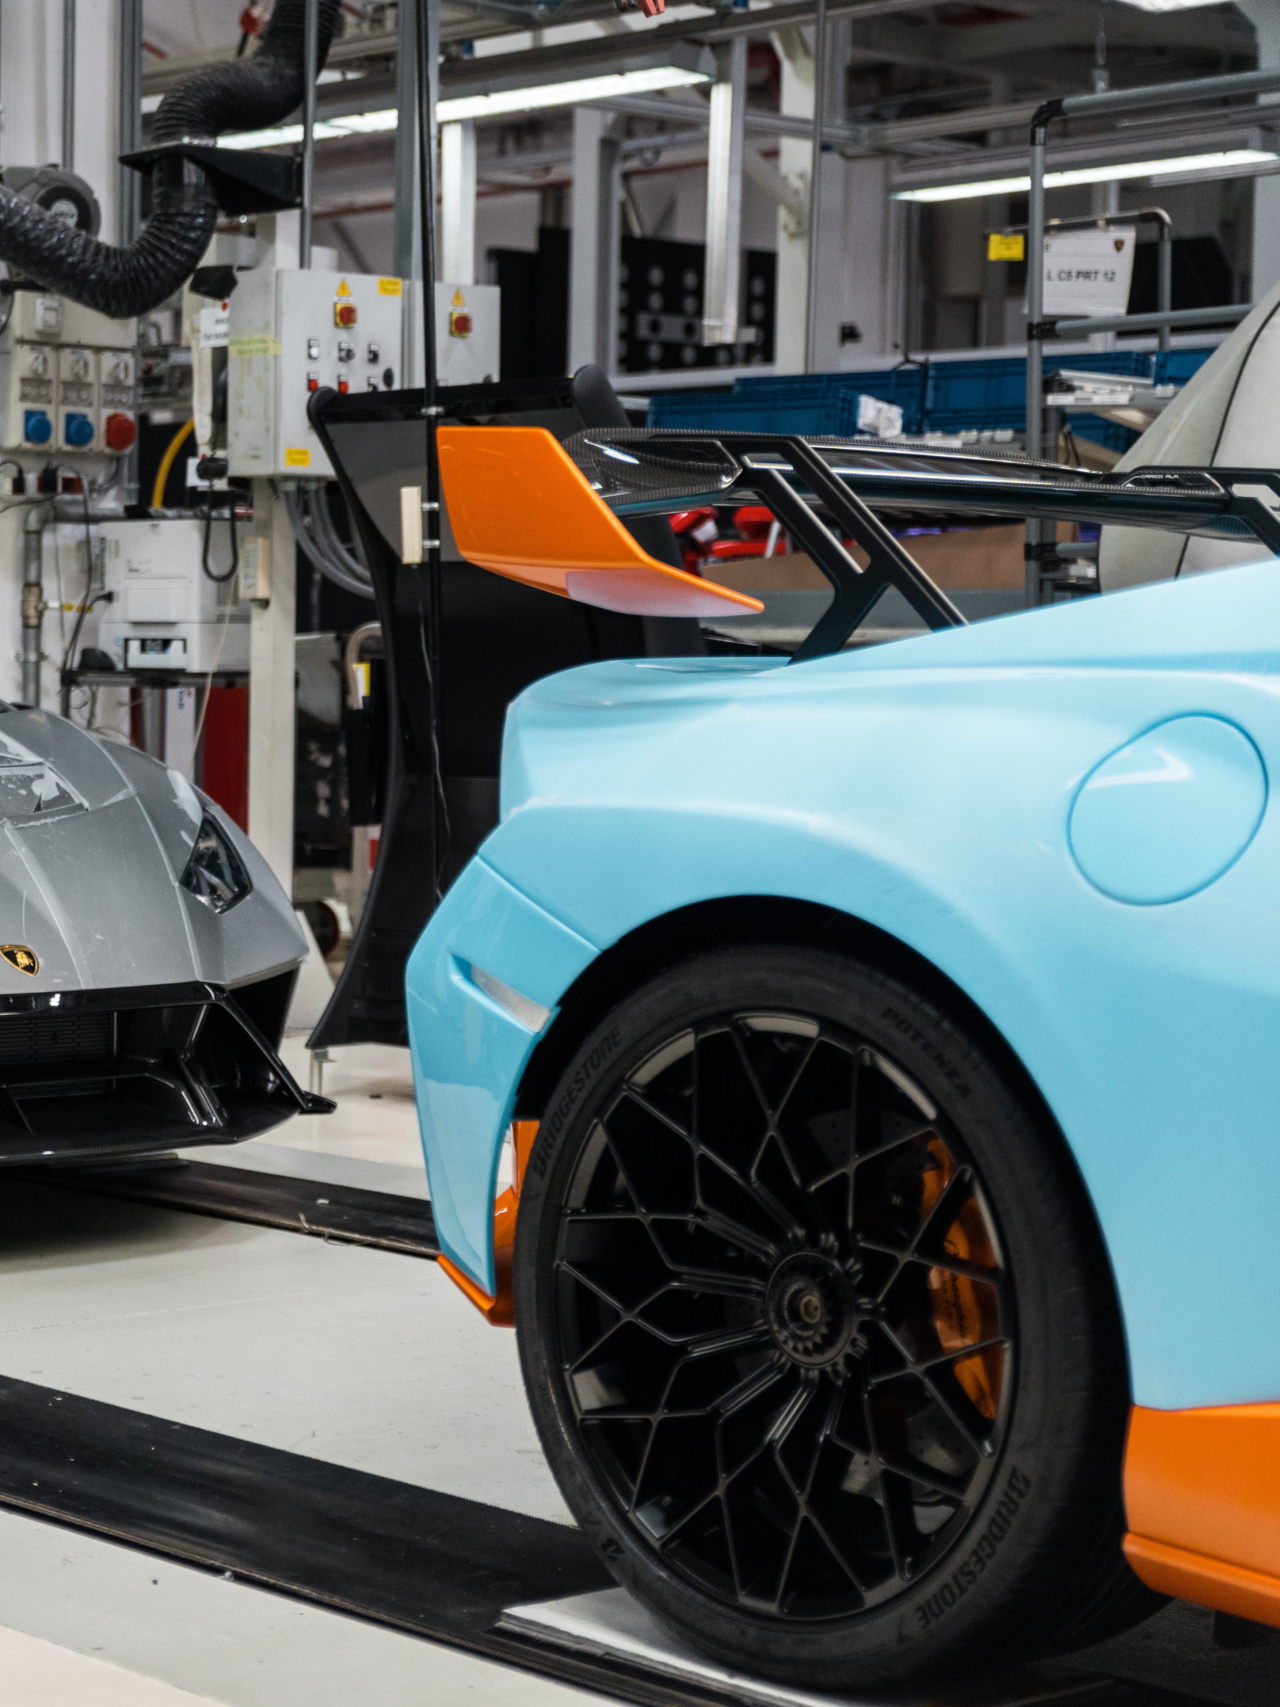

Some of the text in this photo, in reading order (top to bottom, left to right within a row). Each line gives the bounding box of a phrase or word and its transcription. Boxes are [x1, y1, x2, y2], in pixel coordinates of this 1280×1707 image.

[1076, 270, 1100, 282] PRT
[1103, 270, 1117, 283] 12
[533, 1026, 622, 1182] BRIDGESTONE
[915, 1465, 1032, 1629] BRIDGESTONE
